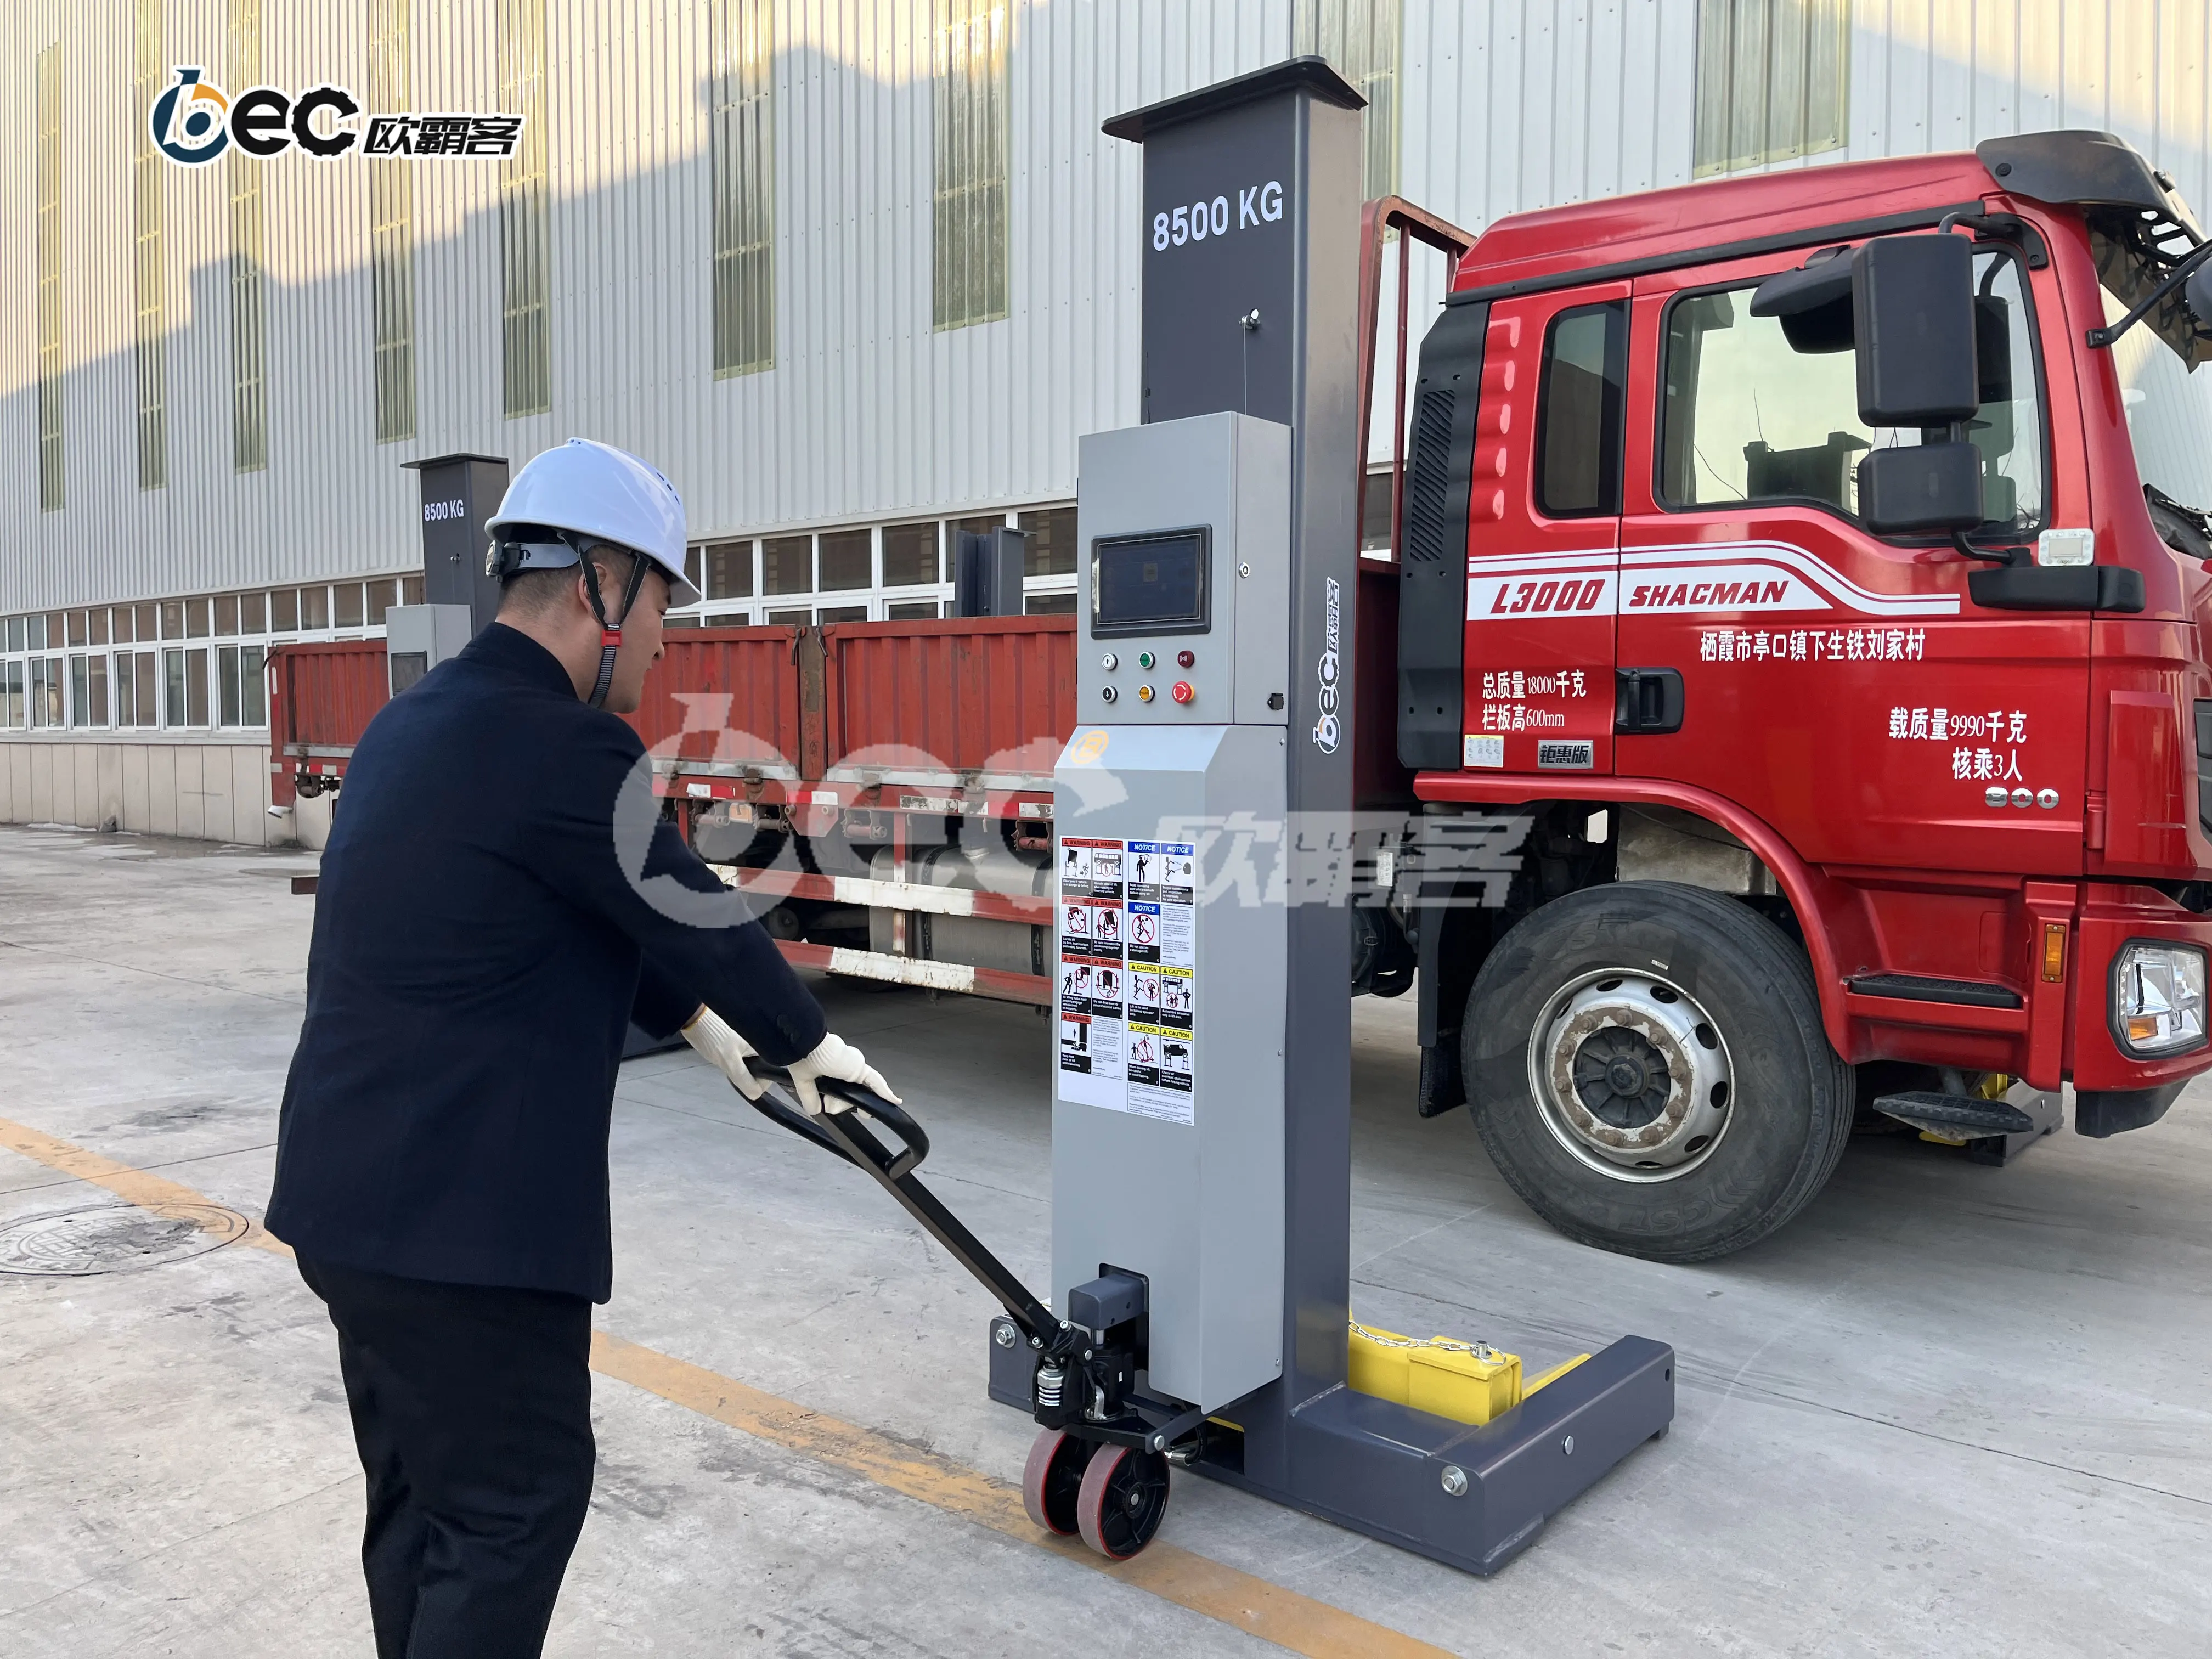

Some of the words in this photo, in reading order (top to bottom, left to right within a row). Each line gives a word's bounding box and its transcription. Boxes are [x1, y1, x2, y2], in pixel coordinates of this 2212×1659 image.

[1153, 212, 1228, 251] 8500
[1239, 180, 1283, 229] KG
[425, 501, 448, 522] 8500
[450, 499, 464, 518] KG
[1490, 579, 1605, 613] L3000
[1629, 581, 1789, 606] SHACMAN
[1700, 628, 1925, 662] 栖霞市亭口镇下生铁刘家村
[1482, 669, 1587, 699] 总质量18000千克
[1482, 703, 1564, 731] 栏板高600mm
[1889, 707, 2027, 743] 载质量9990千克
[1952, 747, 2023, 782] 核乘3人
